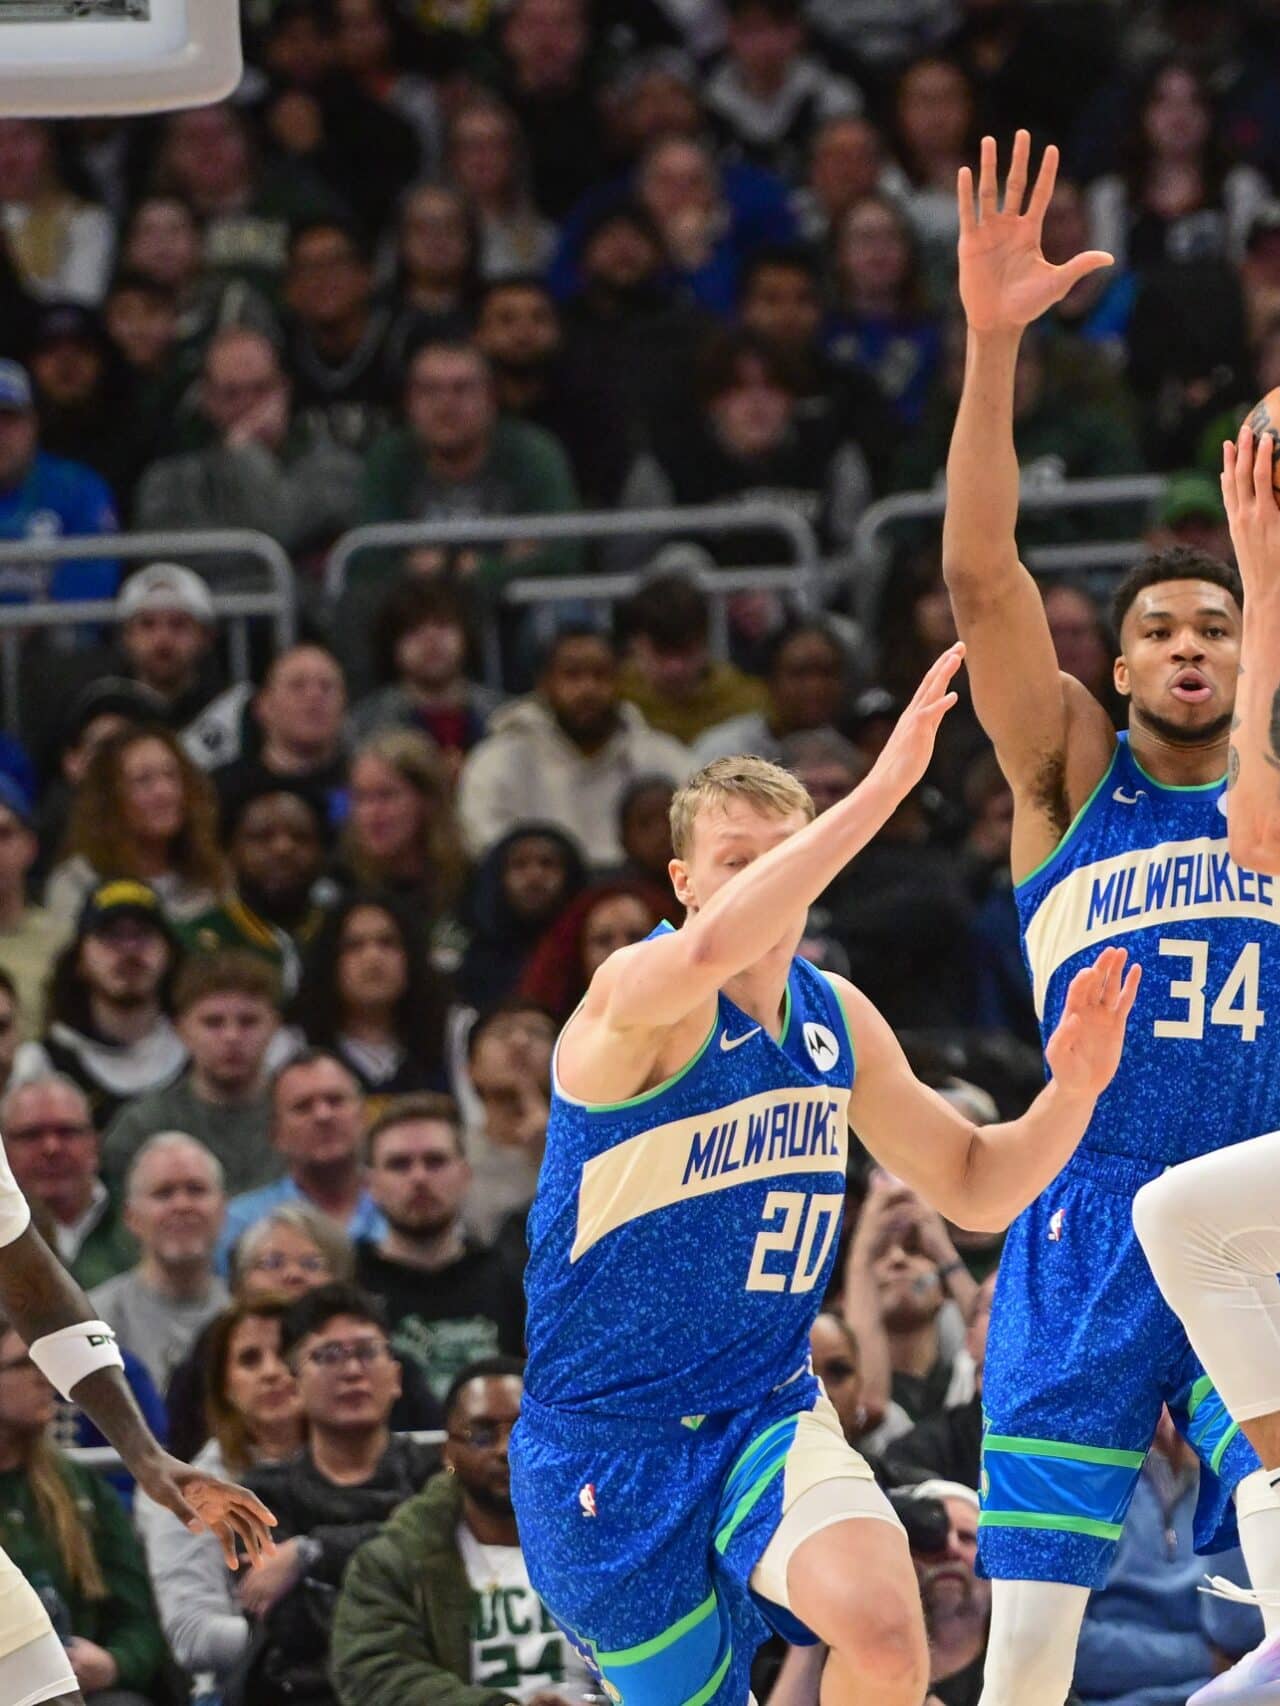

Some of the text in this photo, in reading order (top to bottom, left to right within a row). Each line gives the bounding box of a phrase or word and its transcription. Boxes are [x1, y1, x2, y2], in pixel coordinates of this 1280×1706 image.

[1086, 852, 1274, 932] MILWAUKEE
[1152, 937, 1266, 1042] 34
[744, 1190, 846, 1294] 20
